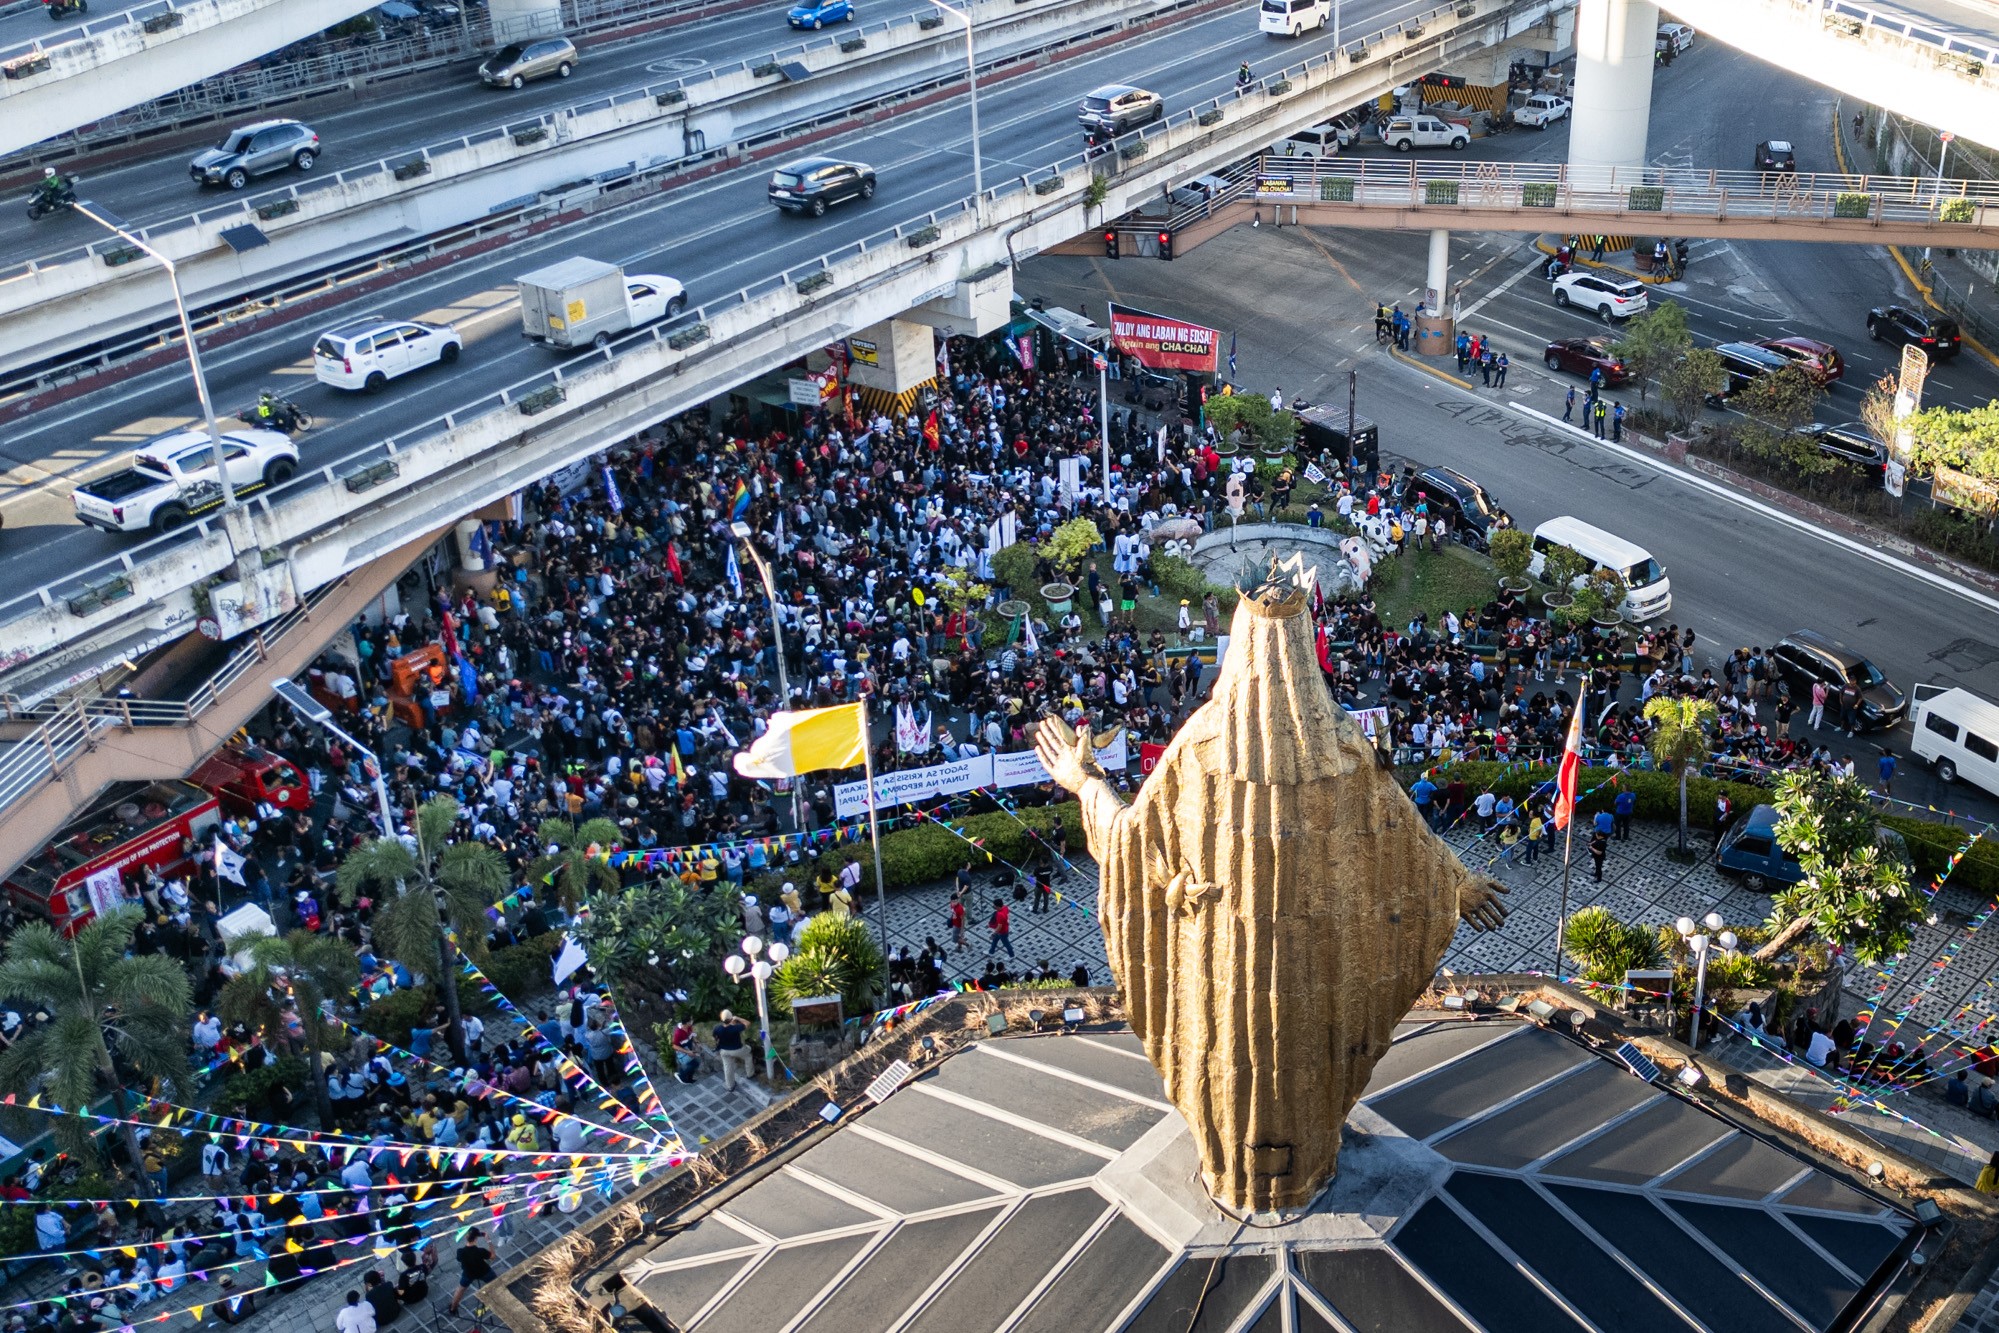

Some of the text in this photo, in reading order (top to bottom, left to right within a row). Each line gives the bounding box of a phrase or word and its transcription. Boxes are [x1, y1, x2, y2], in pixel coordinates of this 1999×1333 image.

[1136, 323, 1151, 338] ANG
[1152, 325, 1176, 341] LABAN
[1178, 327, 1188, 342] NG
[1190, 329, 1213, 344] EDSA!
[1145, 341, 1160, 351] ang
[1161, 341, 1207, 354] CHA-CHA!
[130, 853, 138, 862] OF
[137, 846, 150, 858] FIRE
[149, 831, 180, 852] PROTECTION
